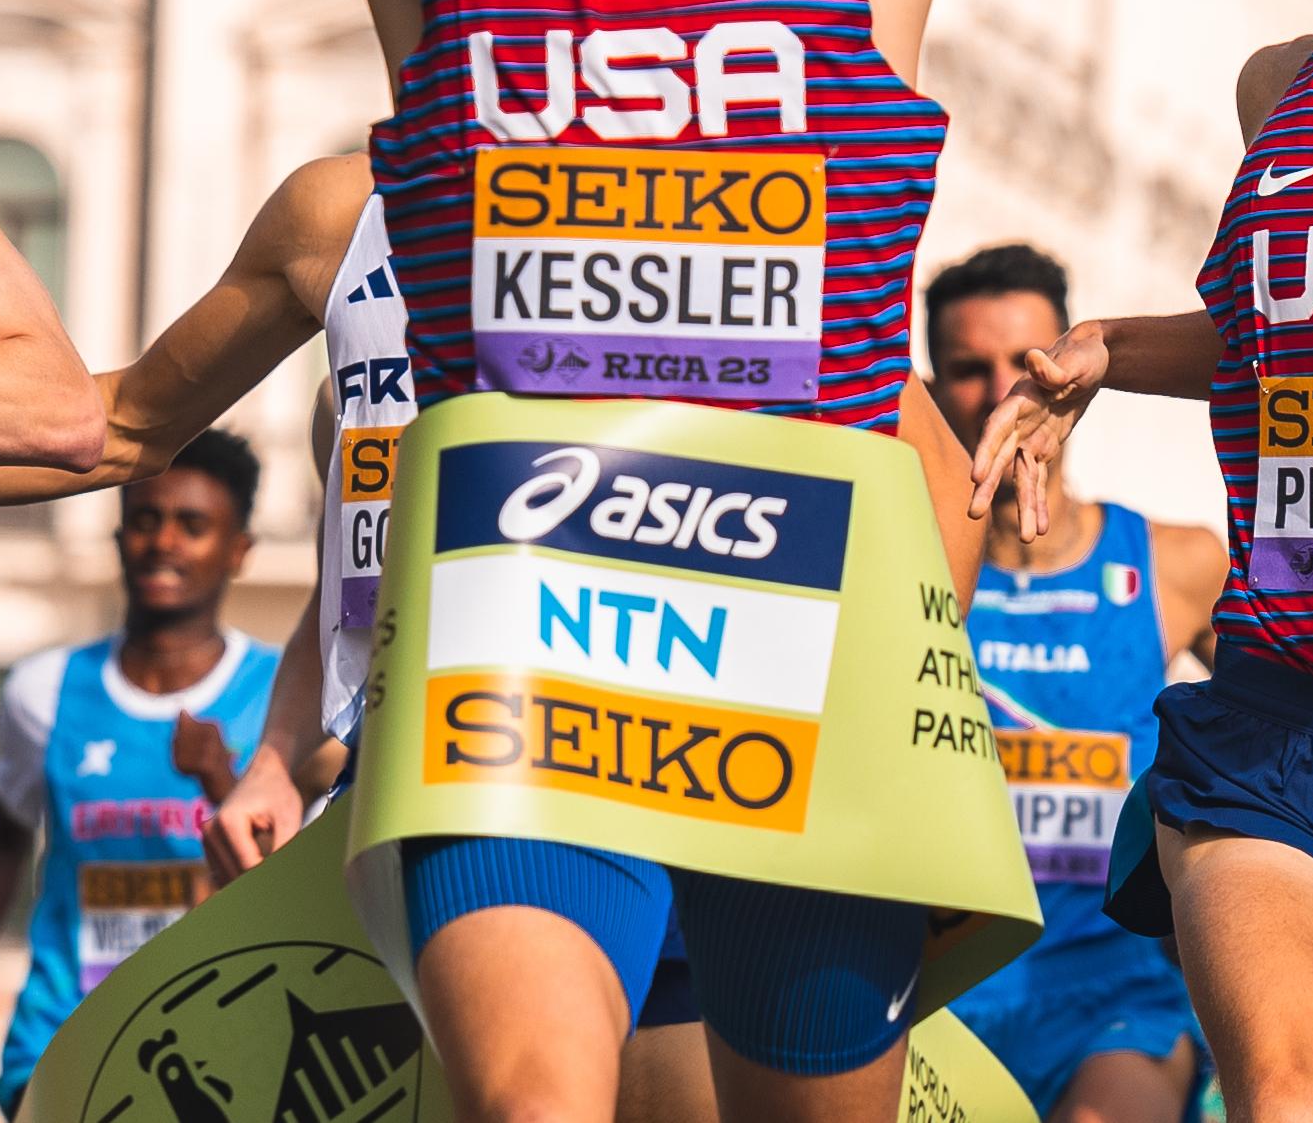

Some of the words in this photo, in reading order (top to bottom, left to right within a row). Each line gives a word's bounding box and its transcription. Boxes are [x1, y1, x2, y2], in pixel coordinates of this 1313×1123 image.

[468, 21, 807, 142] USA
[488, 162, 812, 235] SEIKO
[493, 249, 800, 328] KESSLER
[602, 351, 710, 383] RIGA
[717, 357, 770, 384] 23
[539, 578, 728, 681] NTN
[978, 640, 1091, 673] ITALIA
[444, 690, 793, 810] SEIKO
